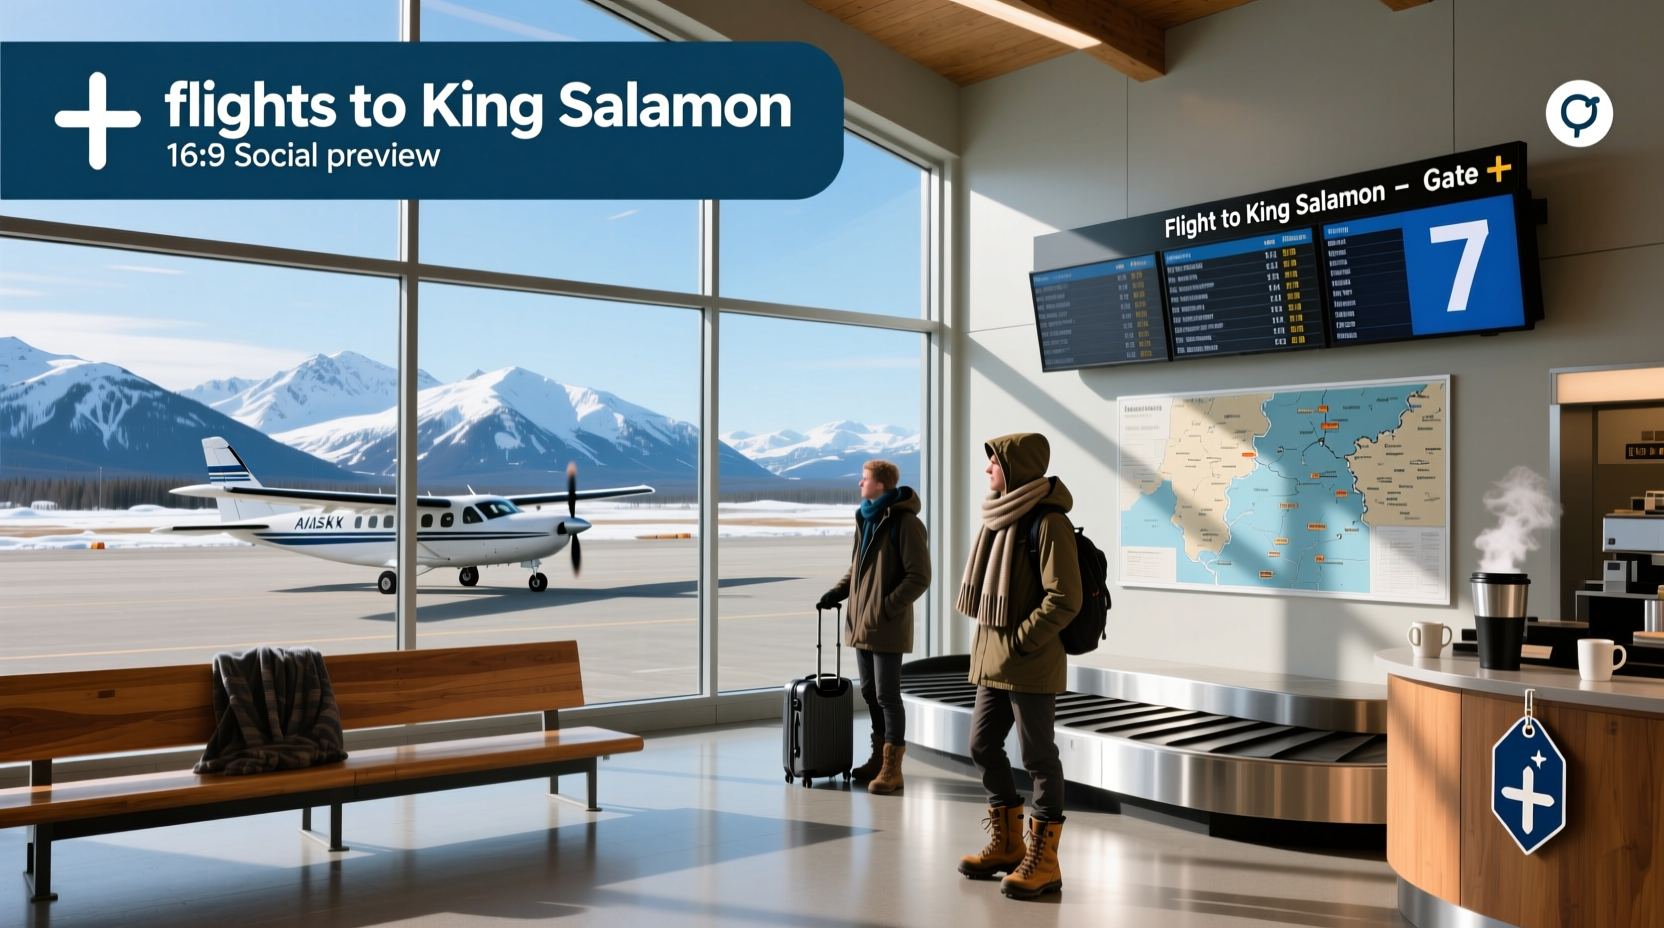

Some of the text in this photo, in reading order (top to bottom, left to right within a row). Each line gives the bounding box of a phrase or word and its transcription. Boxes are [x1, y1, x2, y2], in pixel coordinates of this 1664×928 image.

[1165, 212, 1217, 240] Flight
[1220, 209, 1241, 229] to
[1246, 200, 1290, 224] King
[1295, 184, 1386, 216] Salamon
[1423, 164, 1479, 192] Gate
[1429, 218, 1489, 312] 7
